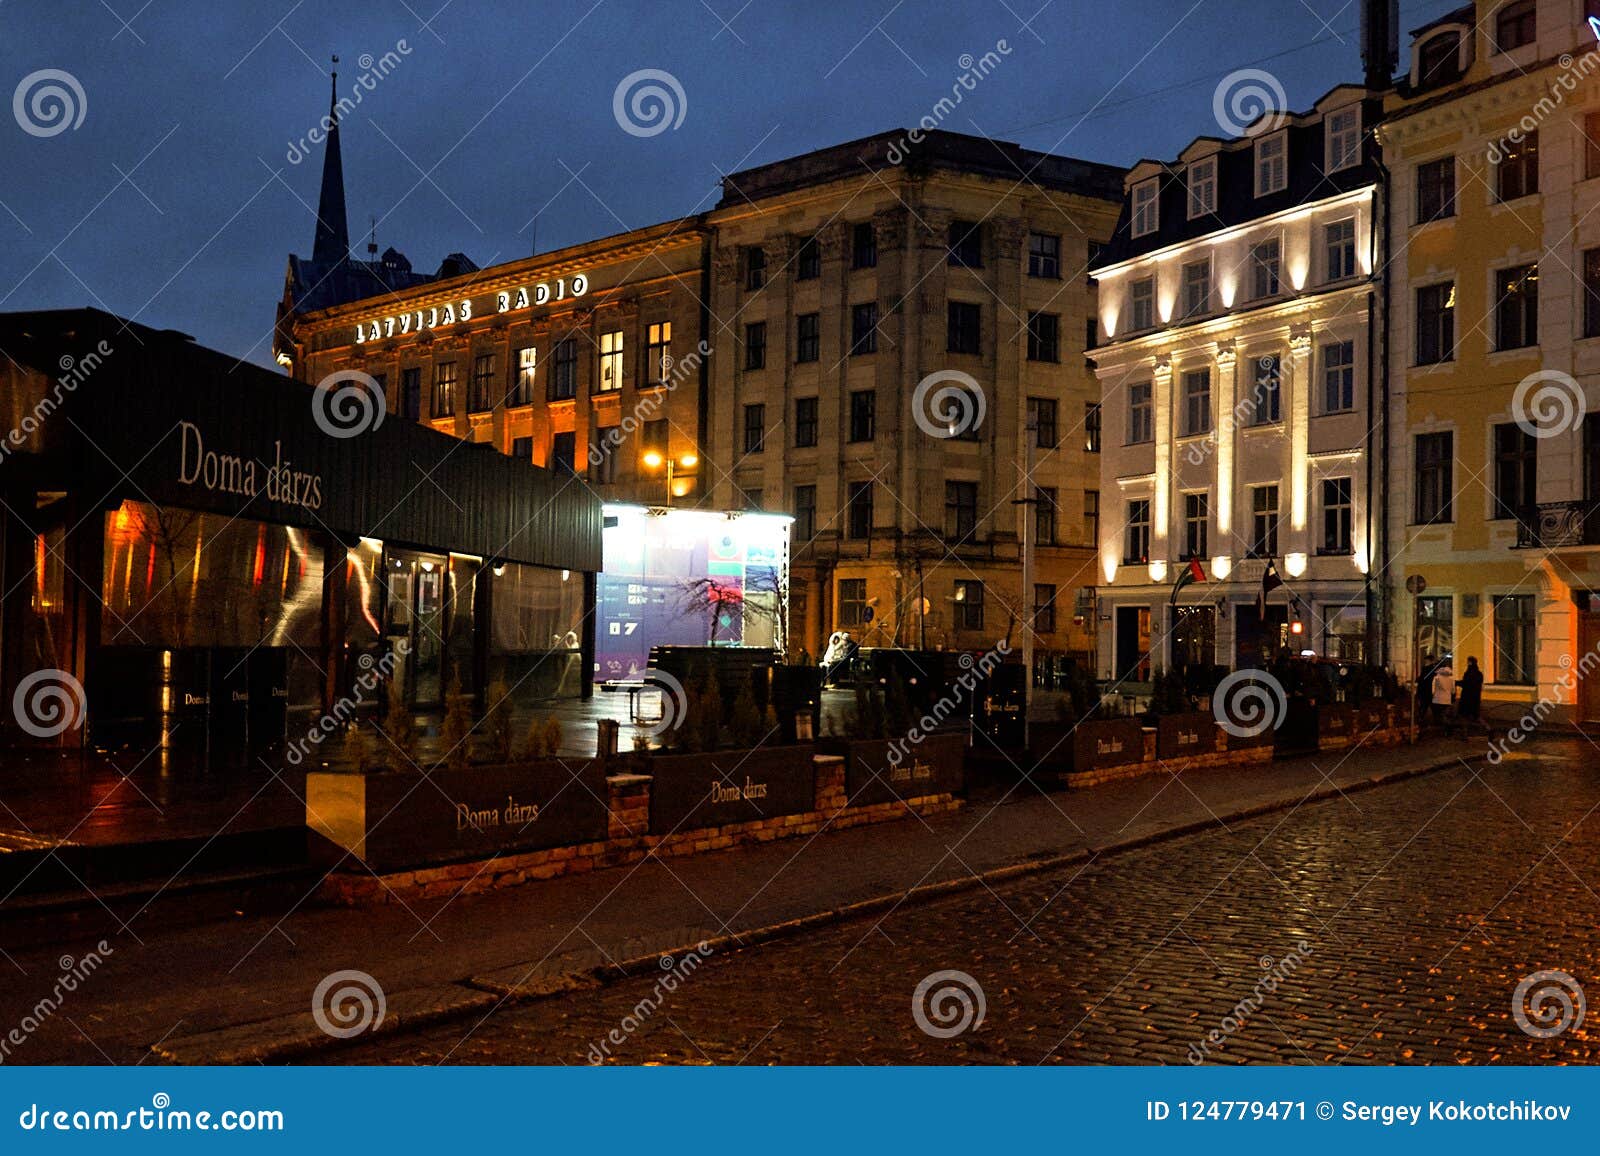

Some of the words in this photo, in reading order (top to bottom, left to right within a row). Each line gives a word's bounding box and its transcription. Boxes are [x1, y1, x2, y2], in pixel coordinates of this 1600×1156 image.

[355, 300, 472, 344] LATVIJAS
[497, 274, 588, 313] RADIO
[178, 422, 257, 497] Doma
[456, 803, 499, 830] Doma
